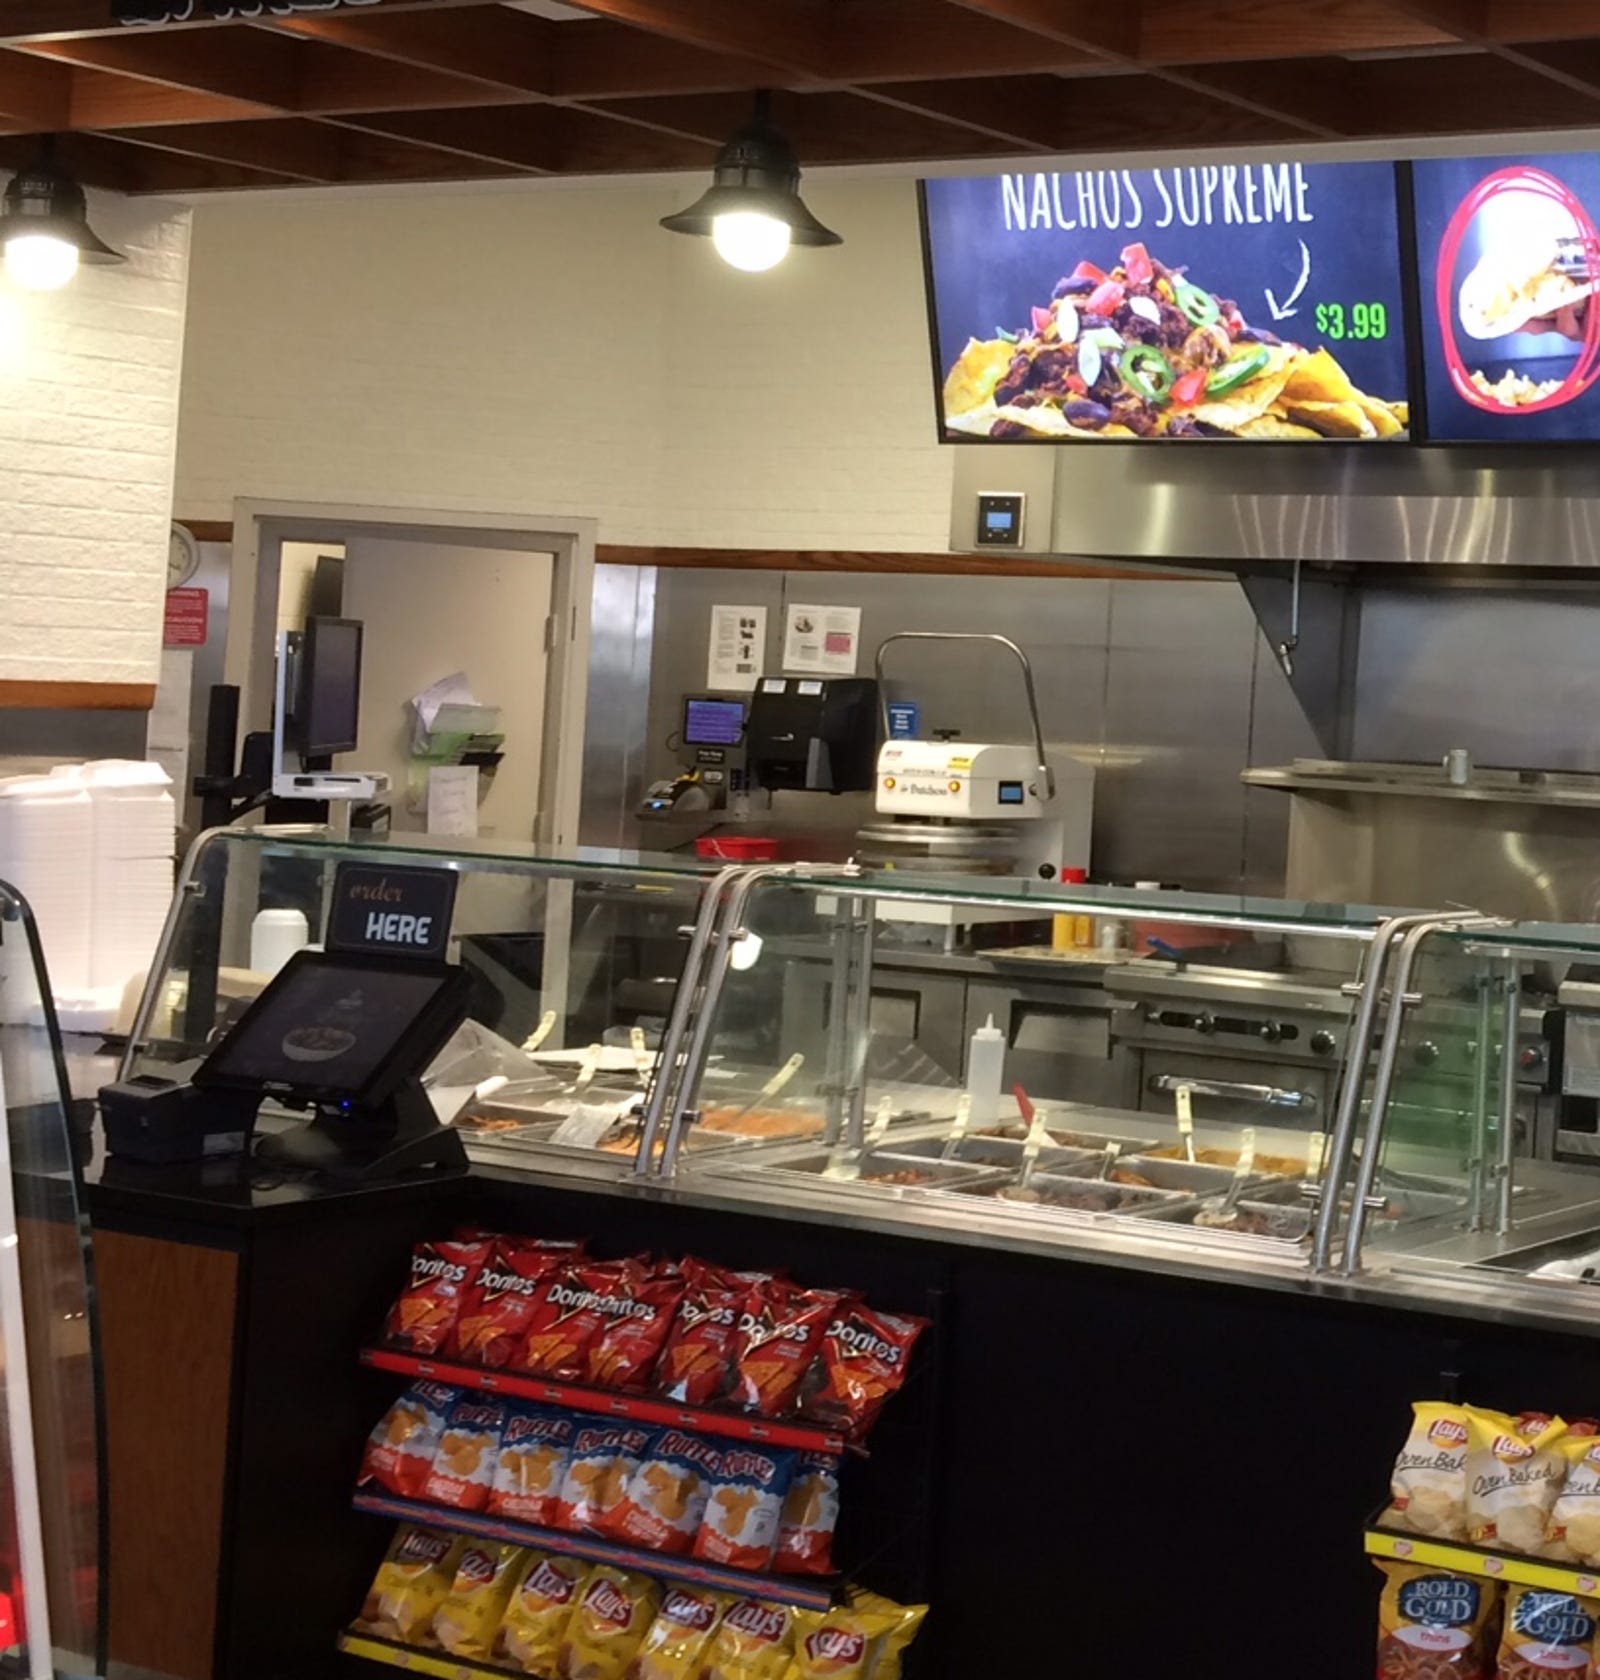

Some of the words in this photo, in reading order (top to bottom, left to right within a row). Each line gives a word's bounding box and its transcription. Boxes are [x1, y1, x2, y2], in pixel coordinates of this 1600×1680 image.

[1001, 169, 1143, 231] NACHOS
[1153, 162, 1314, 229] SUPREME
[1315, 303, 1388, 341] $3.99
[350, 877, 404, 902] order
[365, 911, 432, 944] HERE
[1433, 1452, 1467, 1468] Bak
[1473, 1475, 1506, 1494] Oven
[1414, 1580, 1470, 1600] ROLD
[1404, 1597, 1472, 1622] GOLD
